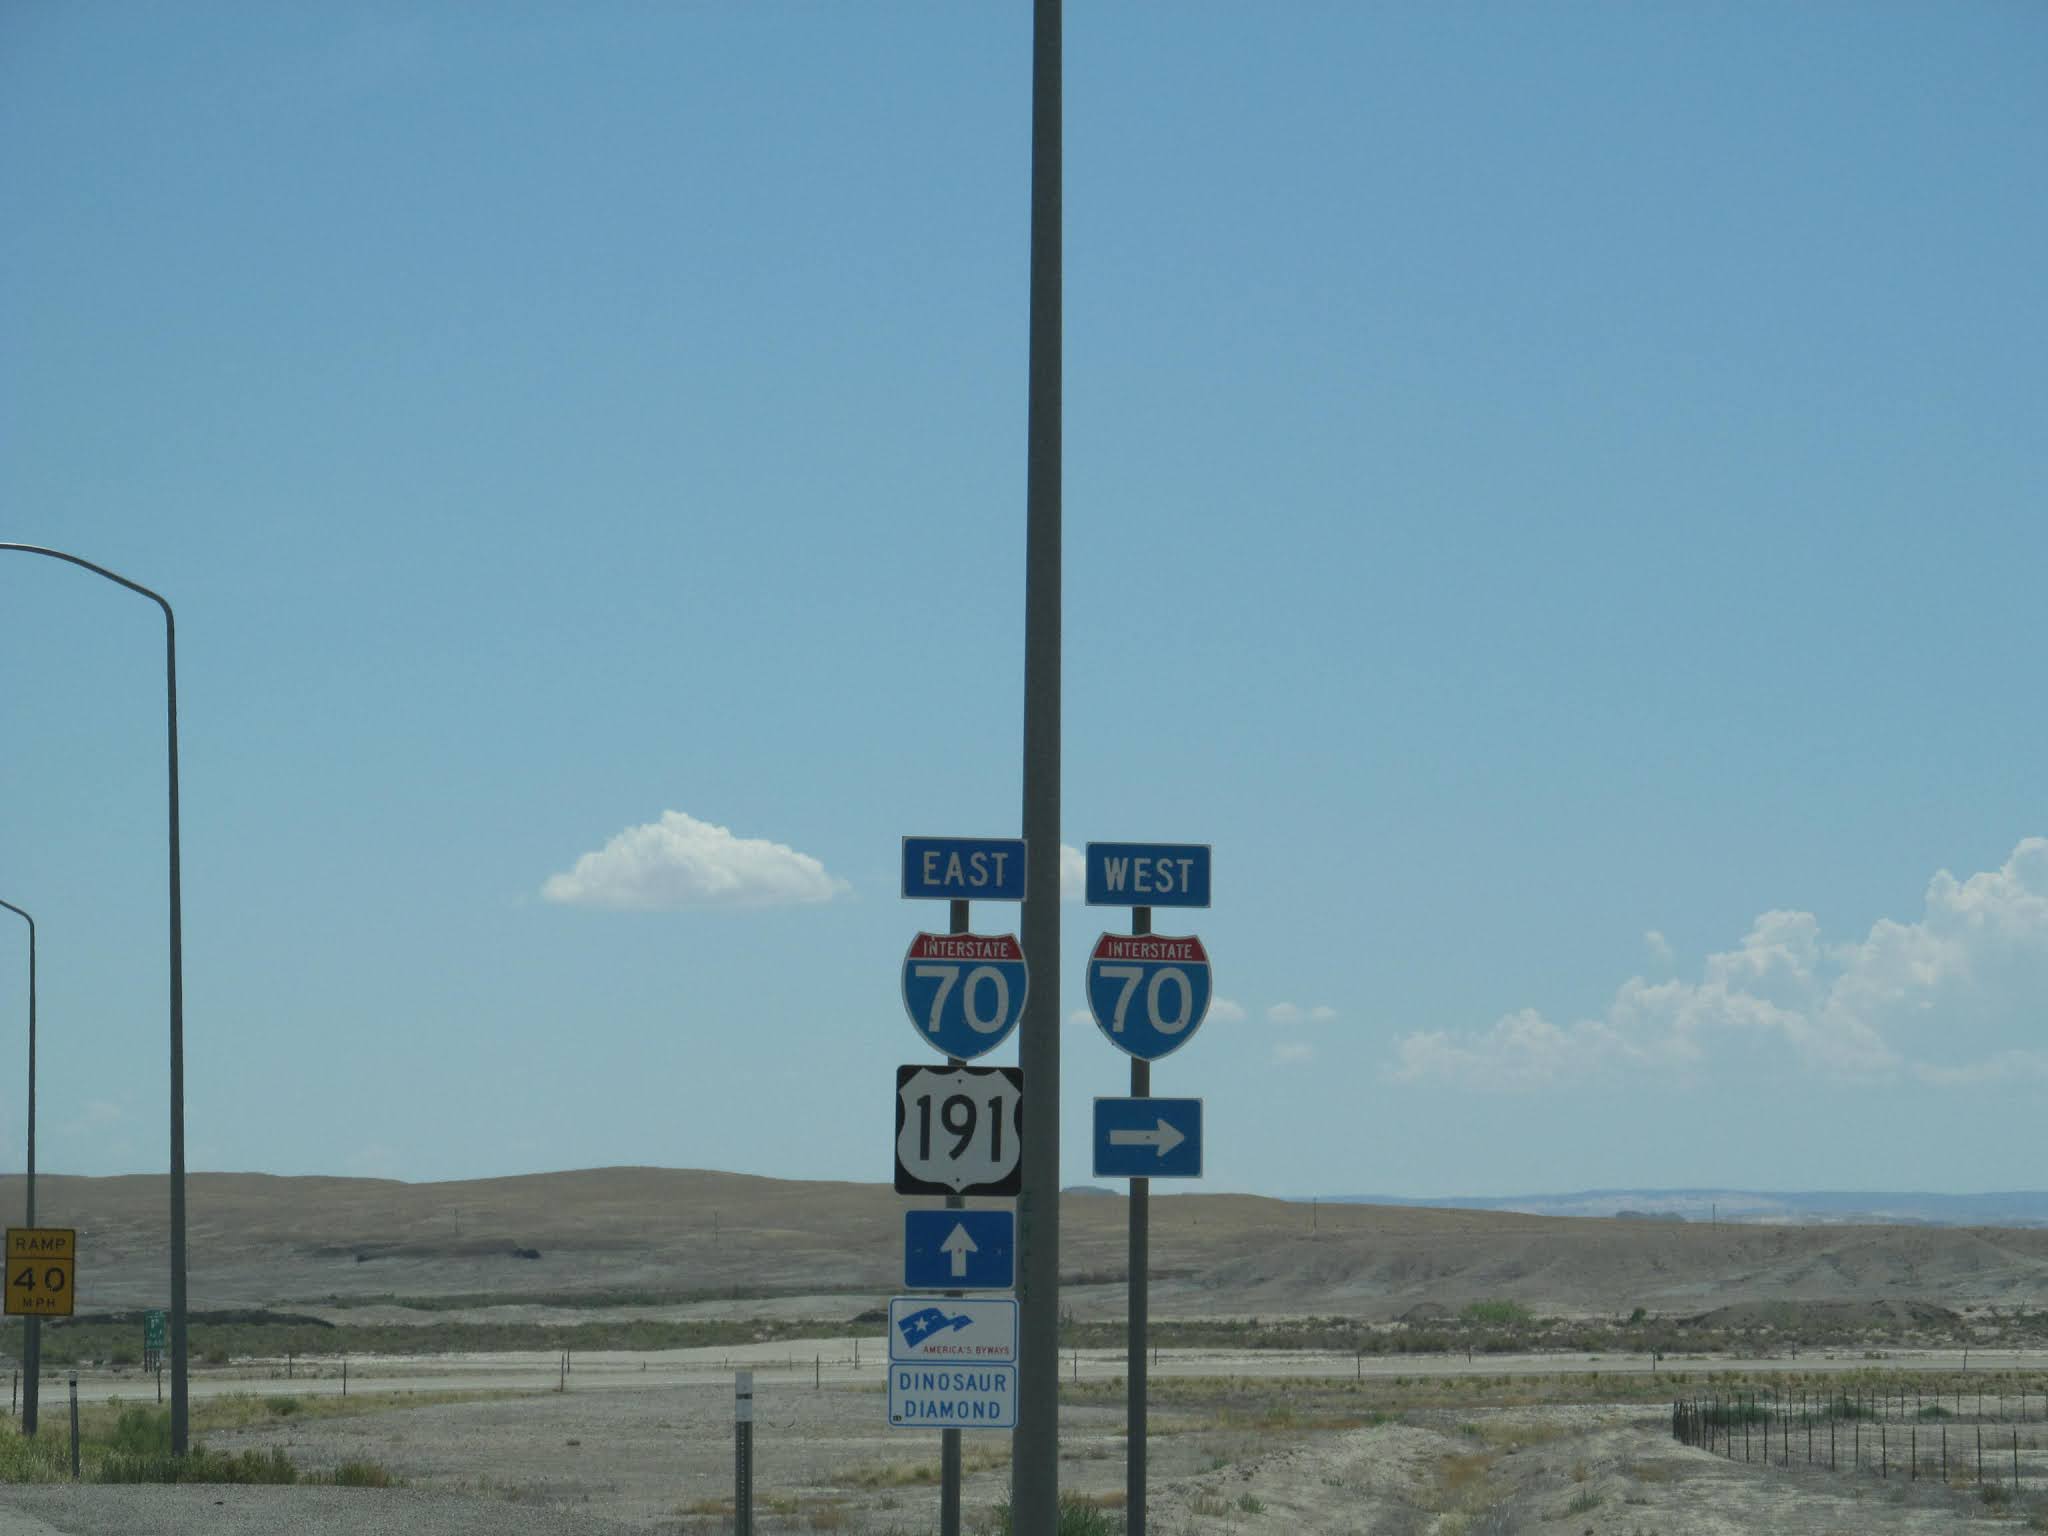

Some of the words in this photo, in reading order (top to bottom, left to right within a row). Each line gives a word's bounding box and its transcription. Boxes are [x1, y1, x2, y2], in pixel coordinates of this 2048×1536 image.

[923, 851, 1009, 887] EAST
[1104, 857, 1194, 893] WEST
[923, 939, 1009, 958] INTERSTATE
[1108, 942, 1193, 960] INTERSTATE
[915, 965, 1009, 1034] 70
[1099, 966, 1193, 1035] 70
[916, 1094, 1003, 1163] 191
[16, 1238, 66, 1251] RAMP
[13, 1267, 65, 1293] 40
[23, 1297, 56, 1308] MPH
[923, 1345, 973, 1355] AMERICA'S
[975, 1346, 1009, 1356] BYWAYS
[899, 1373, 1007, 1392] DINOSAUR
[905, 1400, 1000, 1419] DIAMOND
